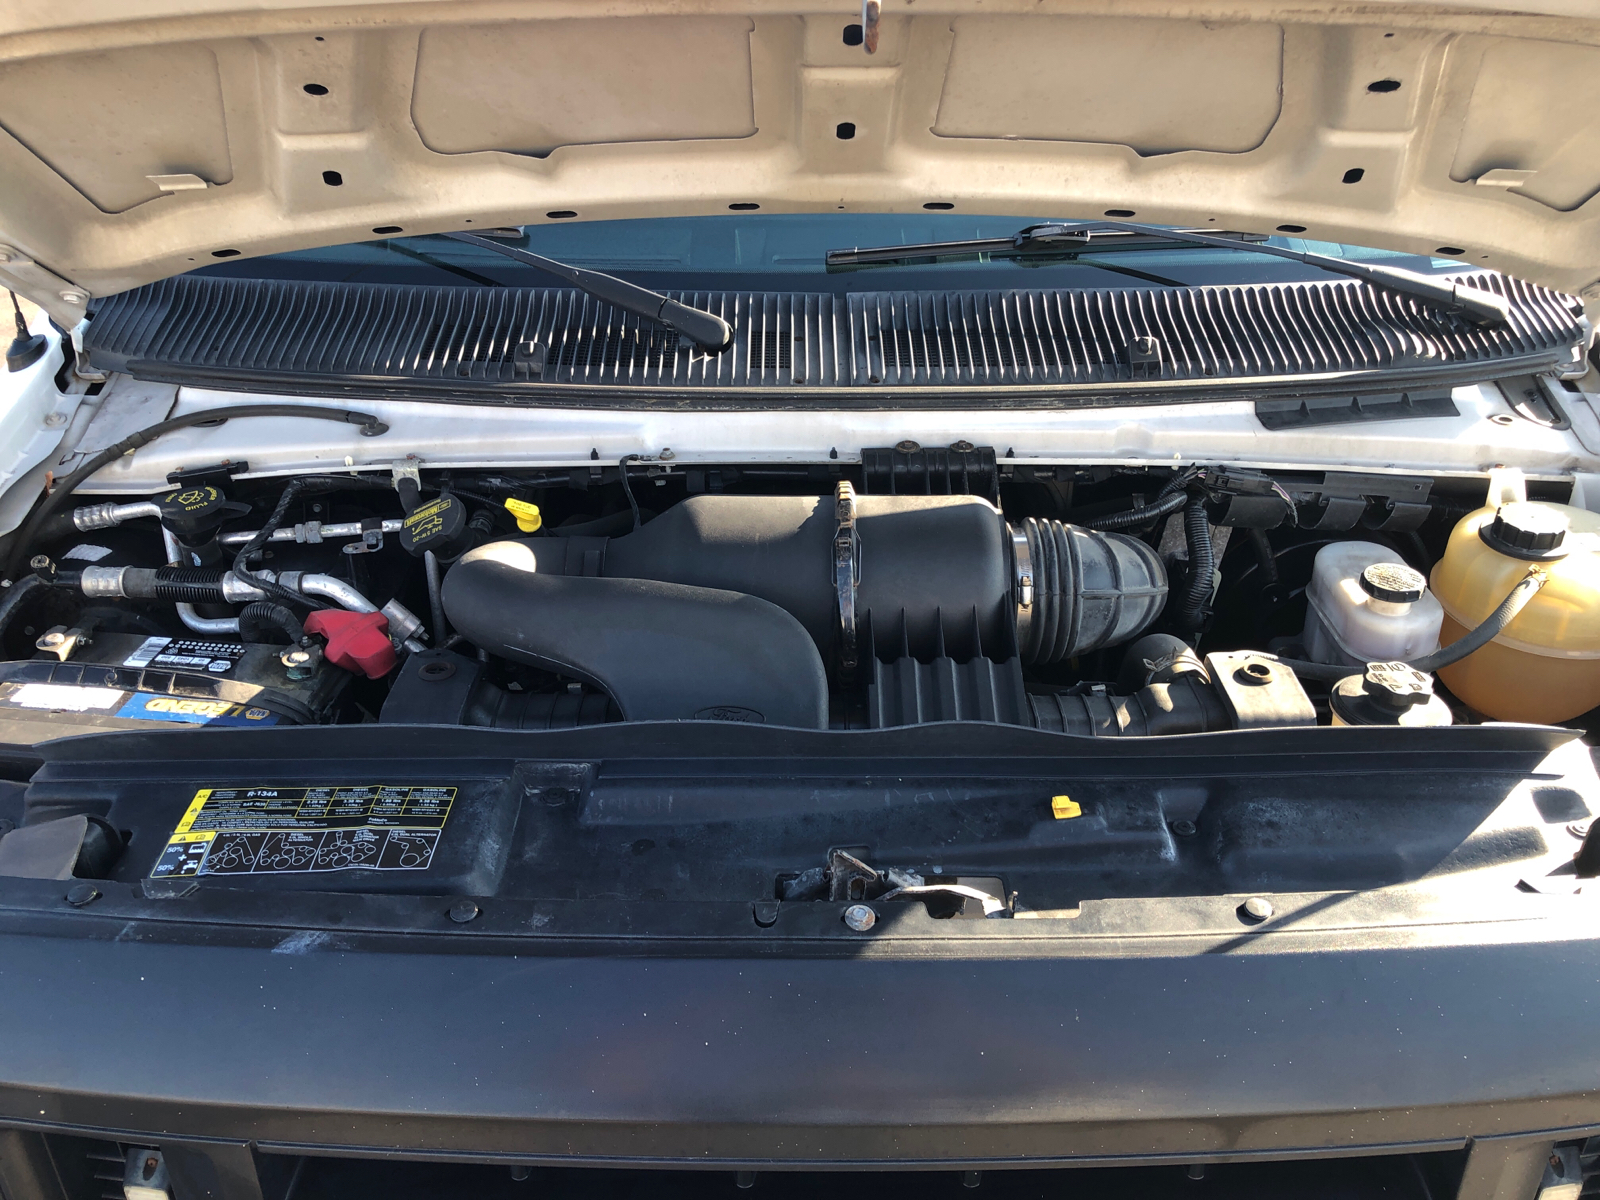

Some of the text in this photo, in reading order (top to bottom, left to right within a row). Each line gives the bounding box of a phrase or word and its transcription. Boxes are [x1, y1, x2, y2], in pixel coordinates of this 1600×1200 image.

[185, 501, 208, 511] FLUID
[406, 506, 438, 525] Motorcraft
[432, 525, 443, 534] SAE
[145, 698, 269, 718] LEGEND NAPA
[156, 864, 175, 872] 50%
